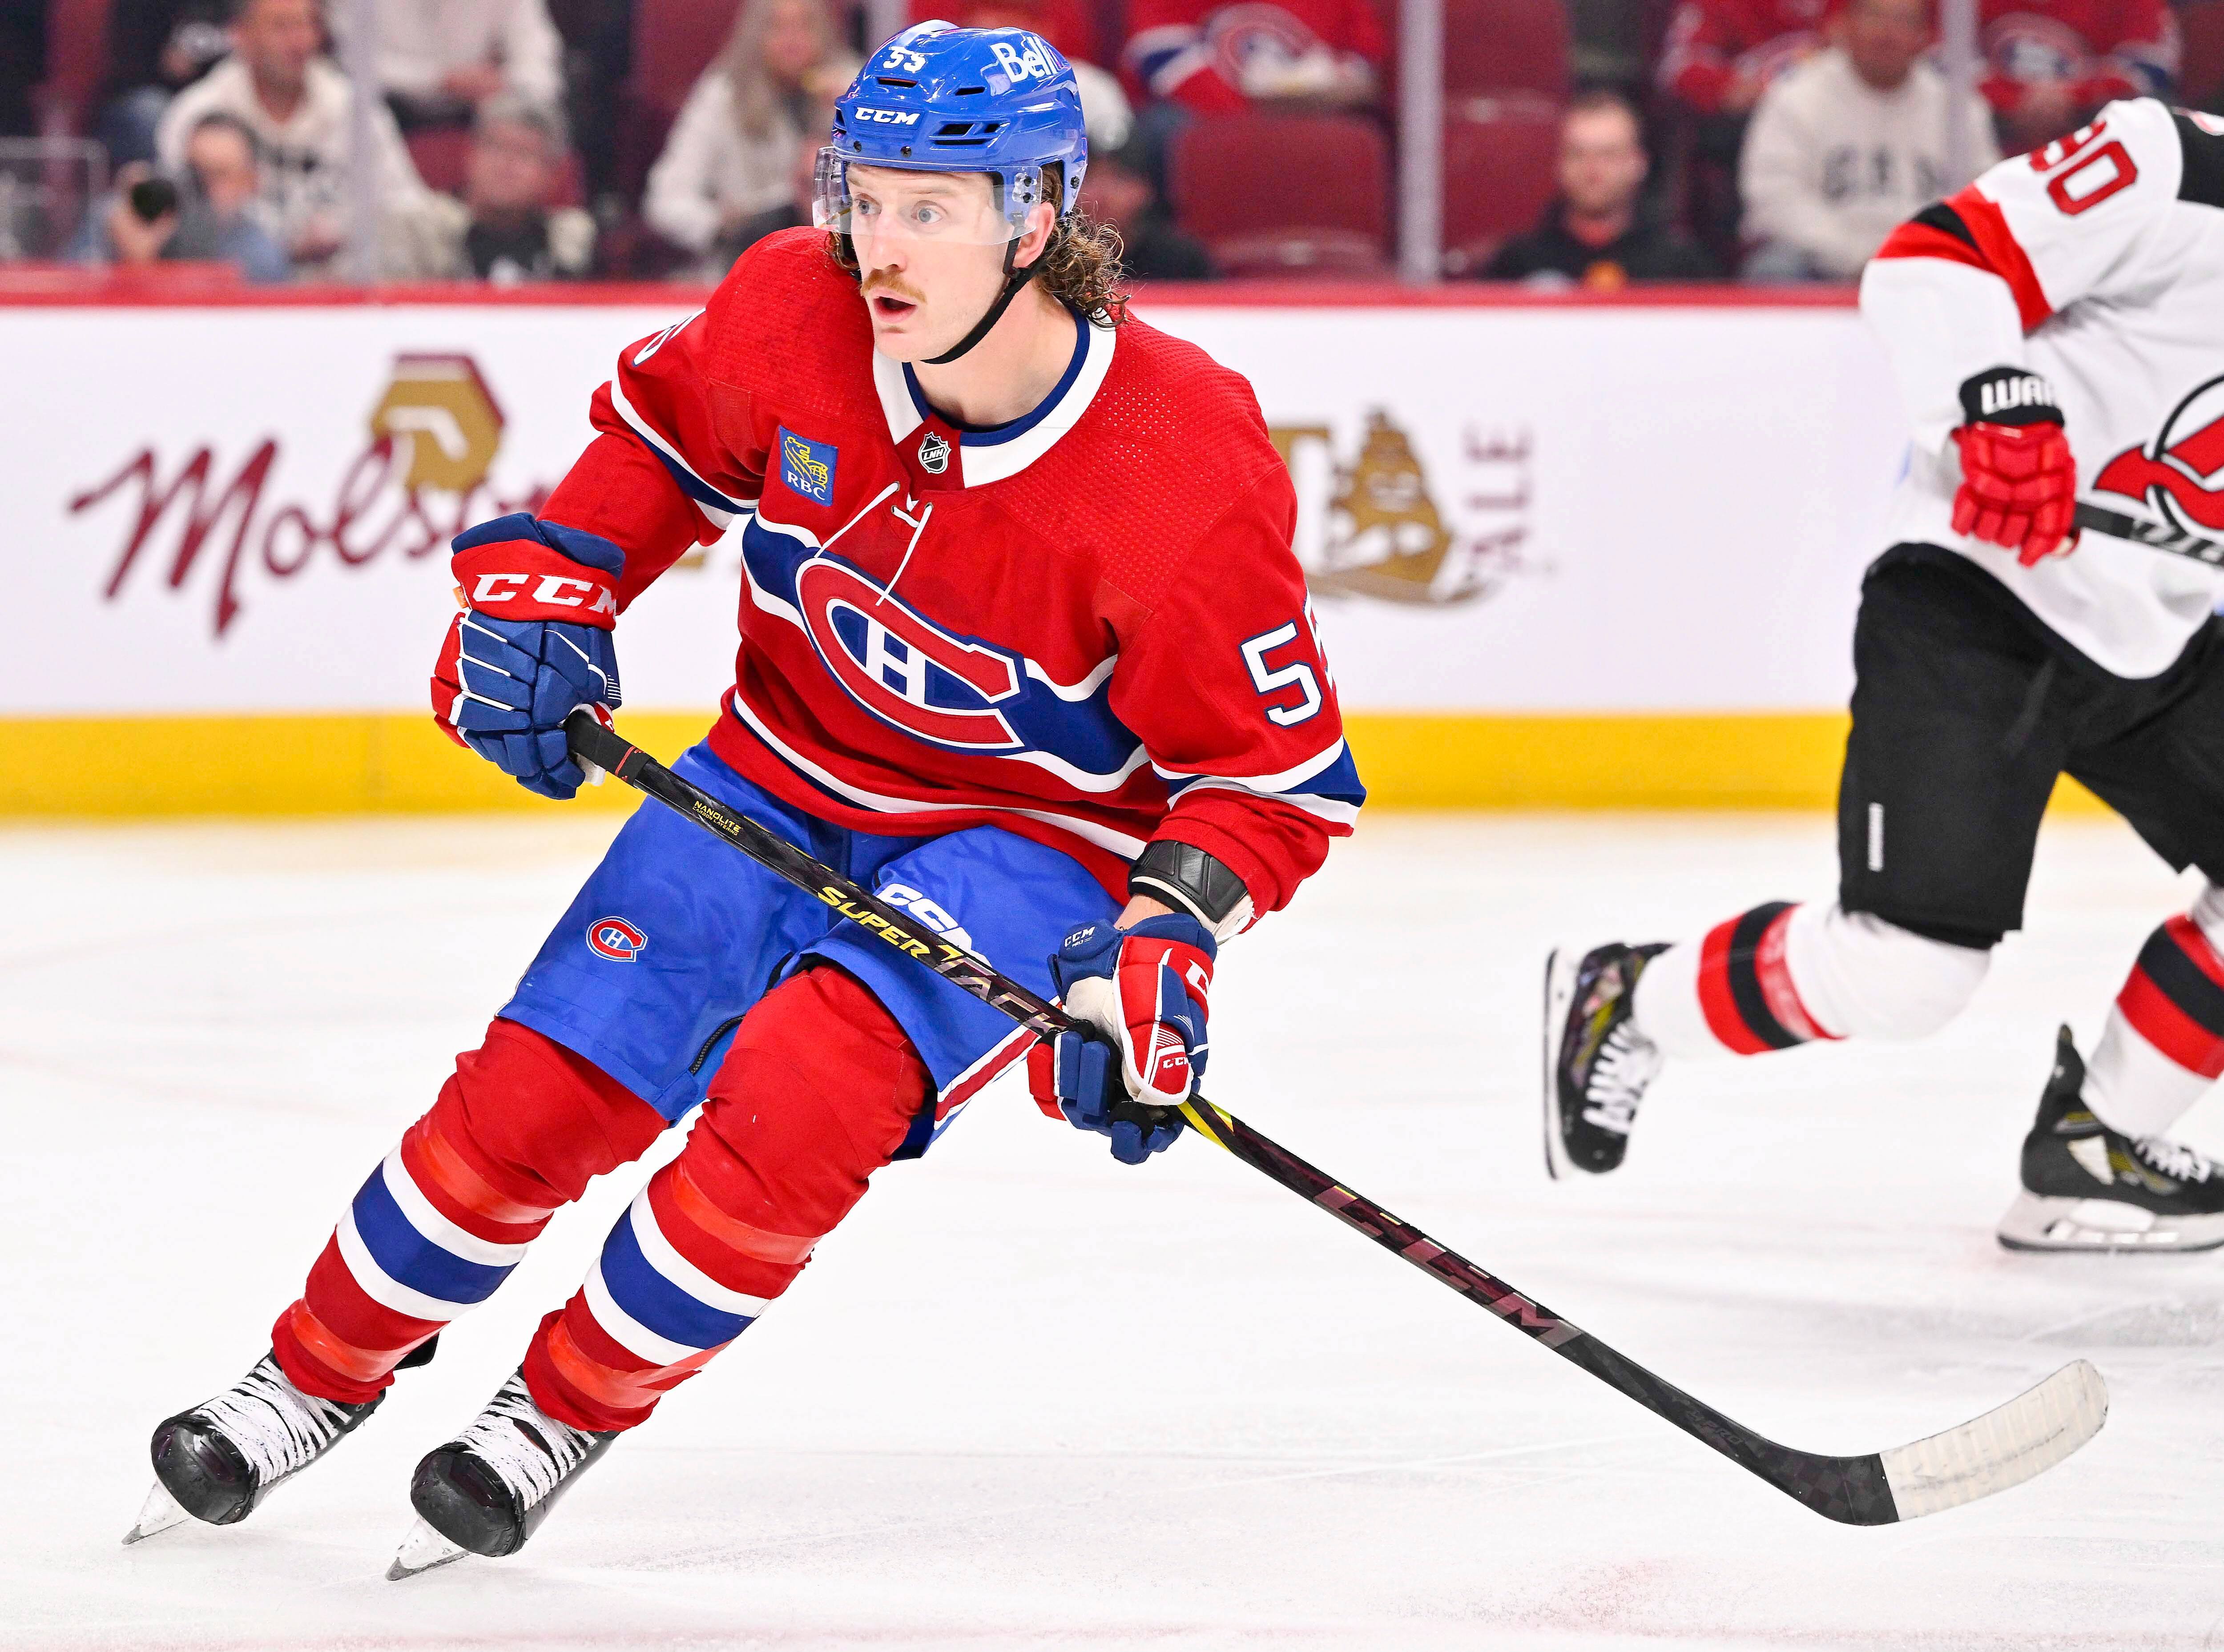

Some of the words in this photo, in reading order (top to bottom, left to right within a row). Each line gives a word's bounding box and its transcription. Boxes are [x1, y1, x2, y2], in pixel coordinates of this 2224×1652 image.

[882, 46, 927, 73] 55
[990, 36, 1058, 83] Bell
[854, 106, 920, 126] CCM
[923, 448, 944, 461] LNH
[787, 470, 825, 501] RBC
[692, 806, 713, 820] CARBON
[694, 800, 741, 833] NANOLITE
[817, 886, 931, 959] SUPER
[1064, 926, 1096, 947] CCM
